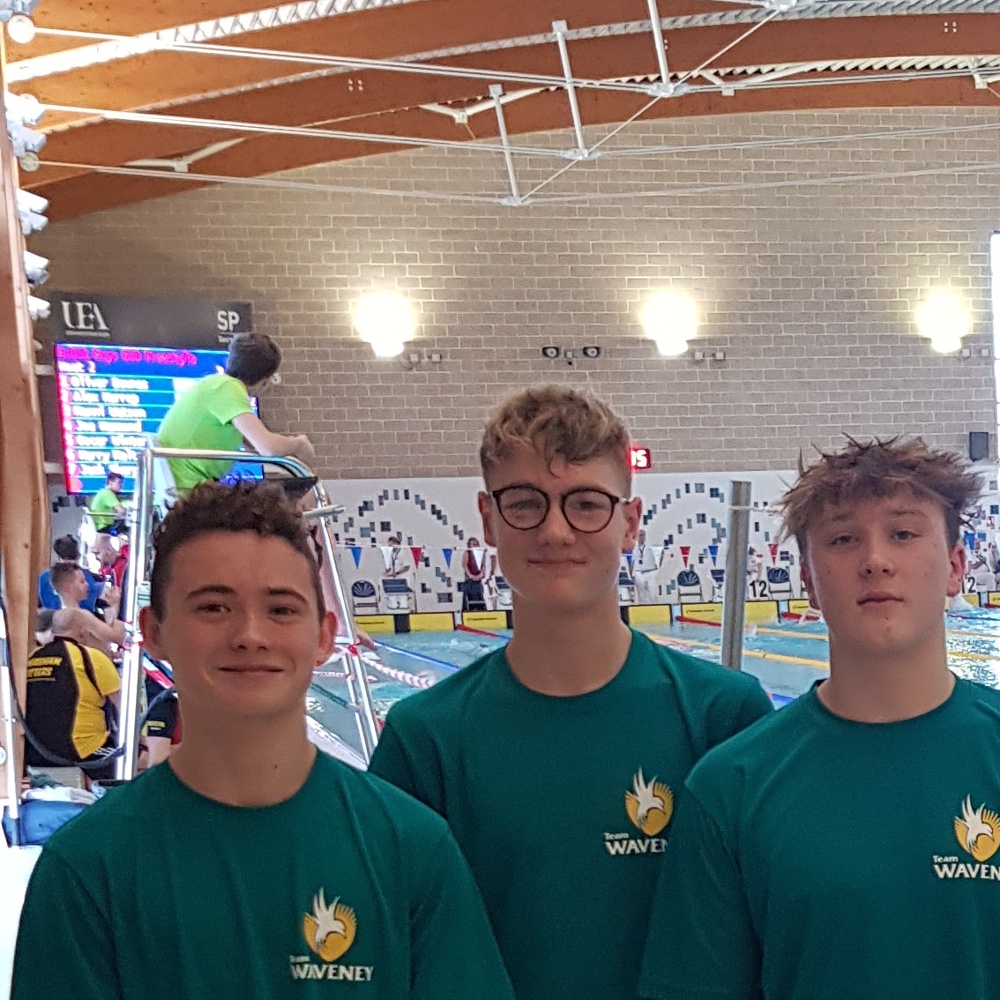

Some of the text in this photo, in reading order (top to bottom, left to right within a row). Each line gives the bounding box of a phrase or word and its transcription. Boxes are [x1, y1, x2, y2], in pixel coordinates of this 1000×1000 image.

[61, 301, 110, 330] UEA
[749, 580, 768, 598] 12
[603, 832, 630, 840] Team
[932, 855, 958, 863] Team
[290, 964, 374, 982] WAVENEY
